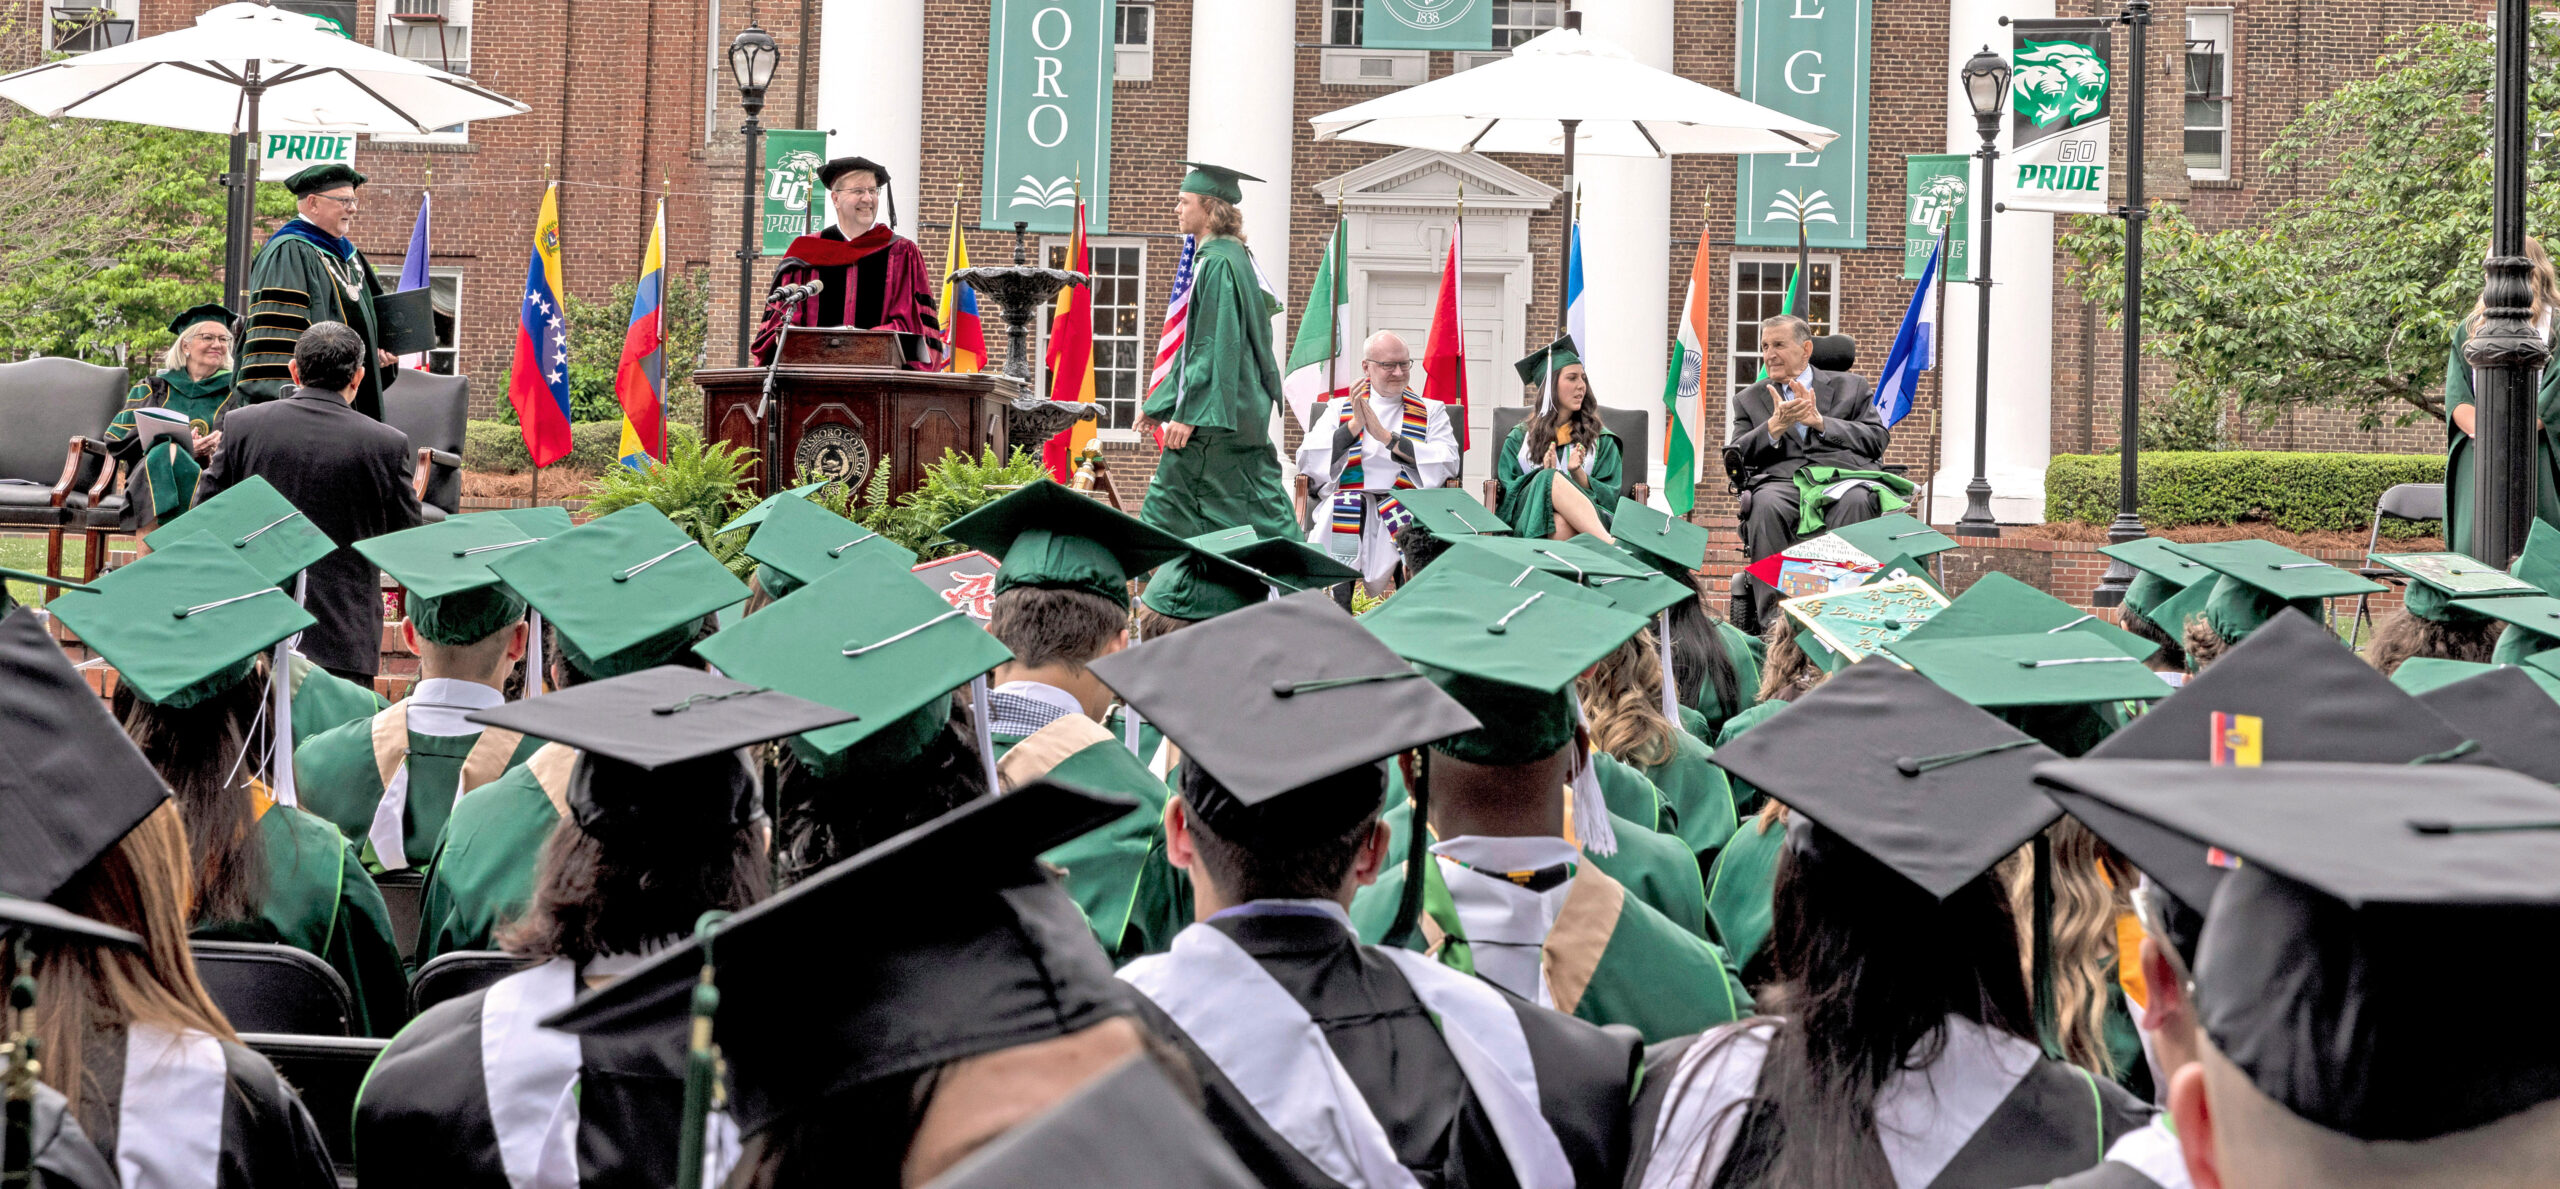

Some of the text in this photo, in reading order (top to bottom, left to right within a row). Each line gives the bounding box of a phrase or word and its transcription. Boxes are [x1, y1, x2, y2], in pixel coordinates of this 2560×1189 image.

[1416, 11, 1440, 24] 1838
[267, 134, 353, 162] PRIDE
[2057, 140, 2097, 163] GO
[2016, 164, 2105, 192] PRIDE
[844, 432, 865, 478] COLLEGE
